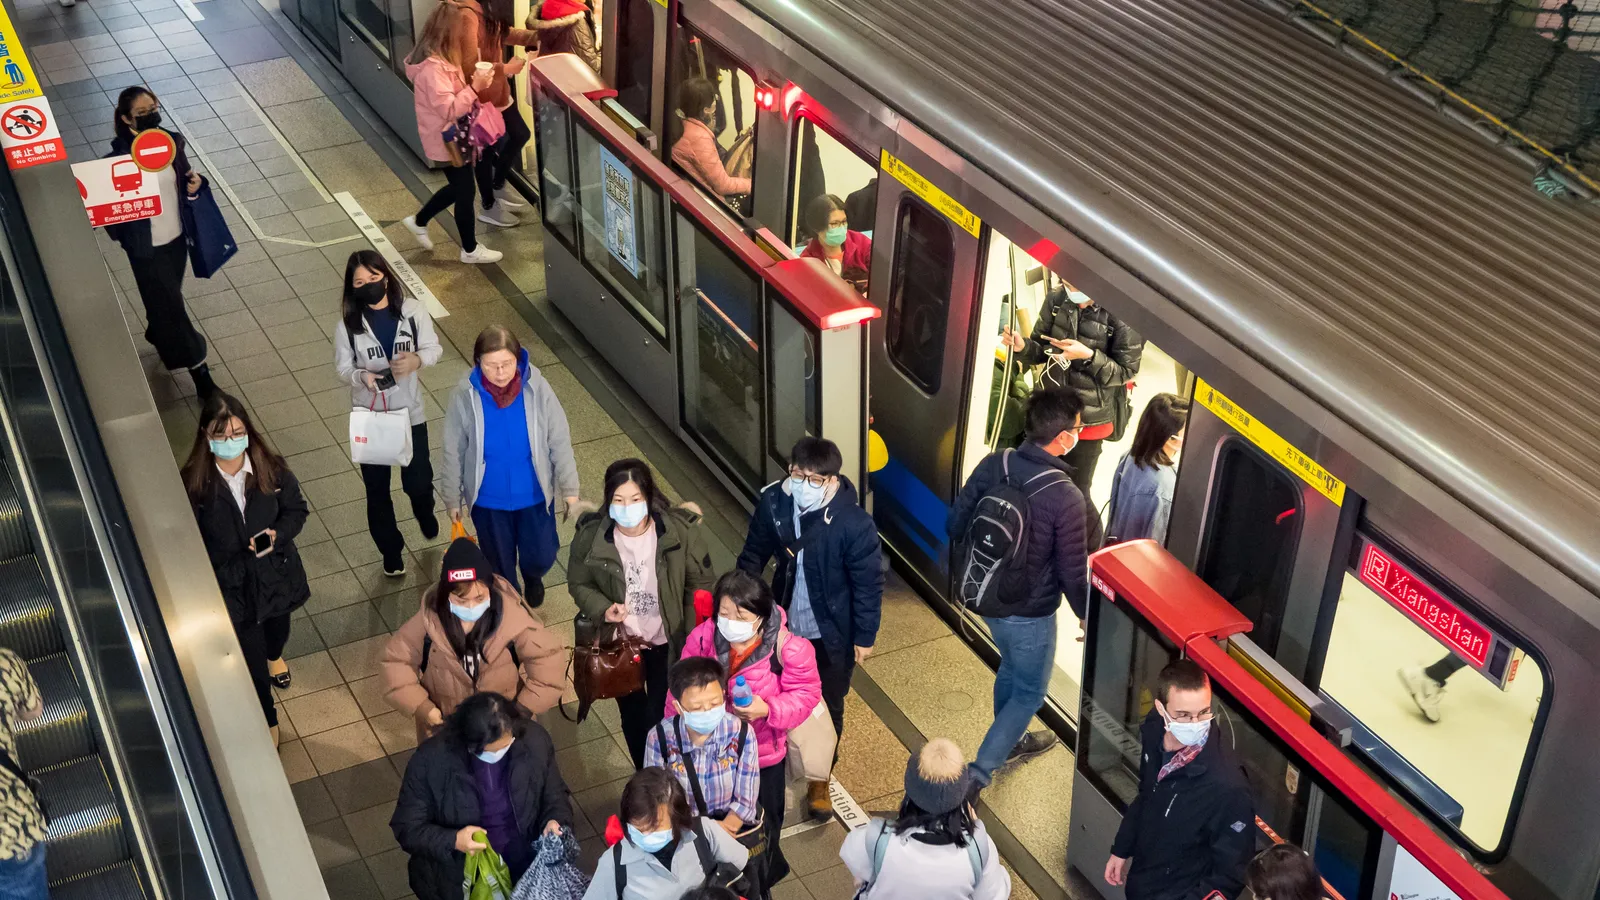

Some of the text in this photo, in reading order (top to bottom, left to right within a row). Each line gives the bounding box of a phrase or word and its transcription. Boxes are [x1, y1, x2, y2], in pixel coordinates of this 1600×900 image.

[12, 88, 35, 97] Safely
[27, 153, 57, 163] Climbing
[112, 199, 154, 215] 緊急停車
[104, 212, 140, 223] Emergency
[140, 209, 155, 217] Stop
[393, 259, 425, 296] Waiting Line
[1390, 569, 1484, 656] Xiangshan
